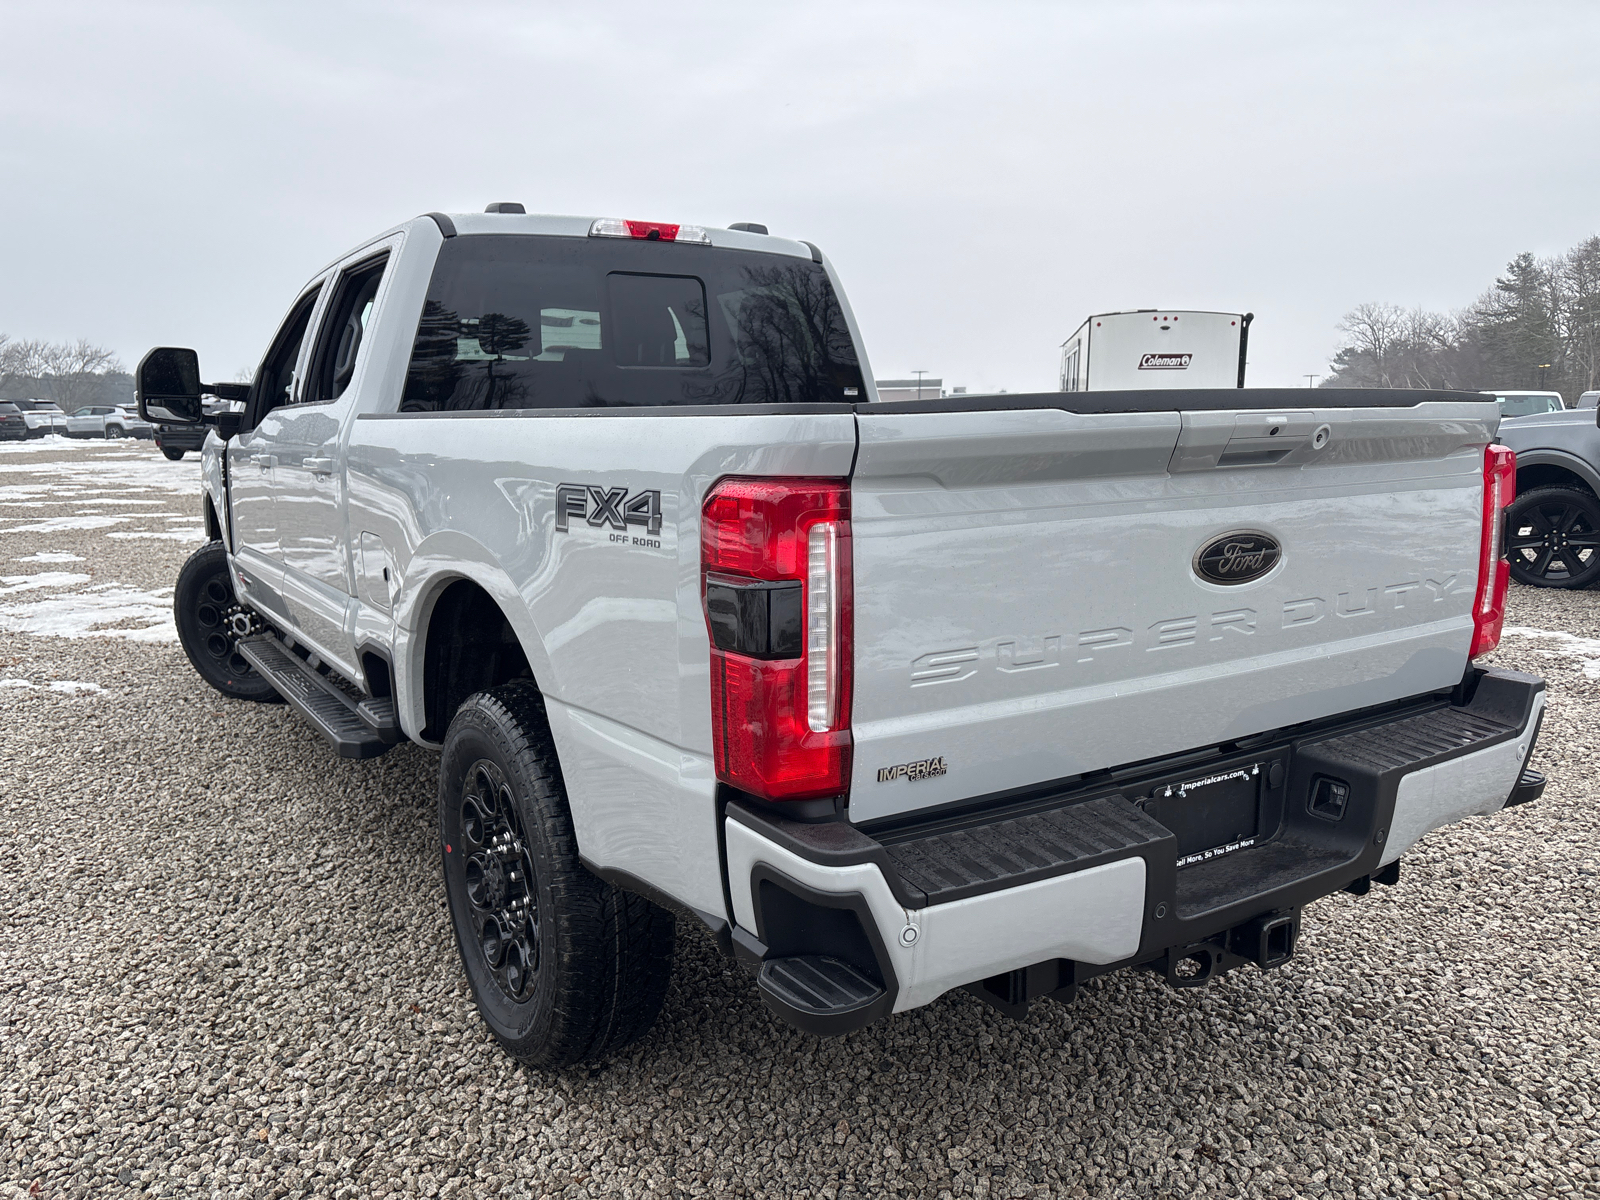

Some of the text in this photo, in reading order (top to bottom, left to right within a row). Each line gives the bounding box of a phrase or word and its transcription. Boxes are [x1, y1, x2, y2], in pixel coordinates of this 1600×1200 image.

[1142, 354, 1181, 367] Coleman
[555, 483, 662, 535] FX4
[609, 533, 661, 549] OFF ROAD
[1218, 542, 1266, 574] Ford
[910, 574, 1457, 688] SUPER DUTY
[877, 756, 948, 782] IMPERIAL
[908, 768, 947, 782] cars.com
[1180, 770, 1245, 791] Imperialcars.com
[1187, 854, 1203, 864] More,
[1204, 851, 1213, 859] So
[1214, 847, 1225, 856] You
[1225, 843, 1239, 852] Save
[1240, 838, 1254, 848] More
